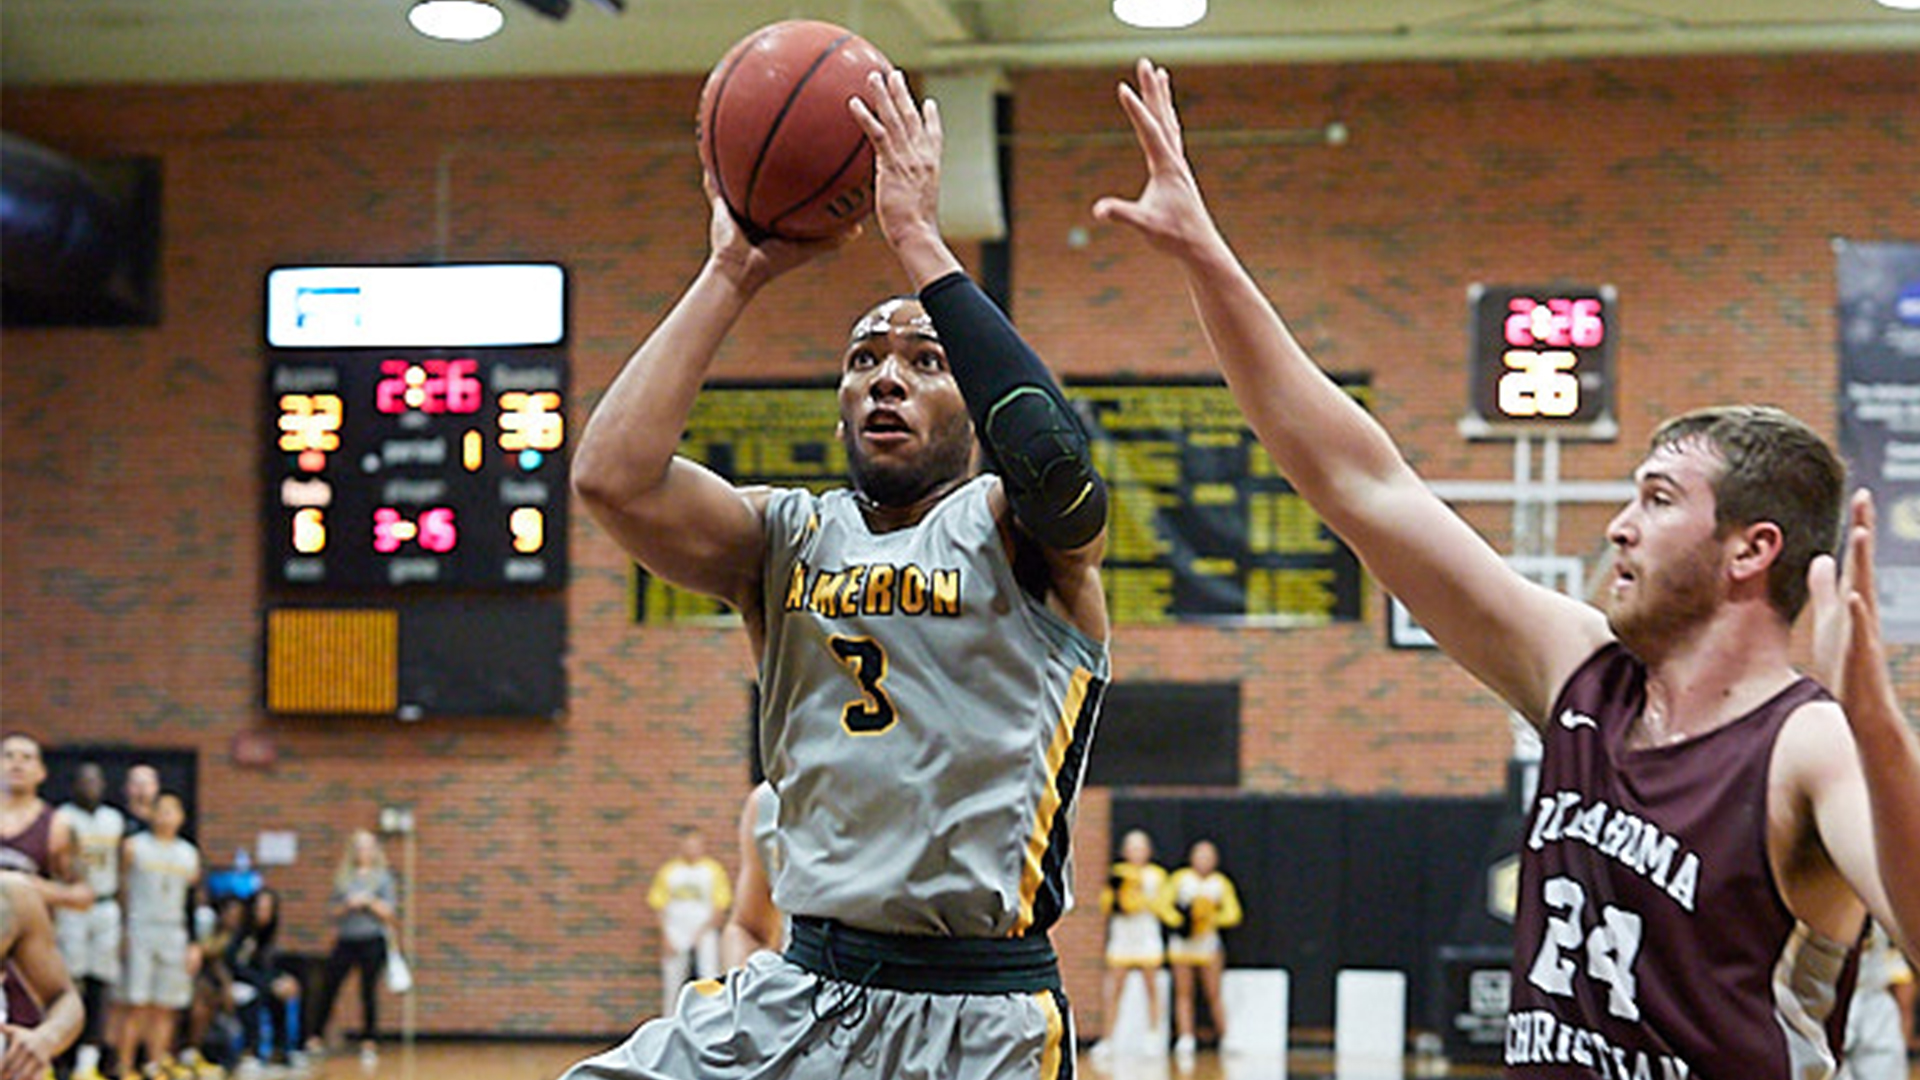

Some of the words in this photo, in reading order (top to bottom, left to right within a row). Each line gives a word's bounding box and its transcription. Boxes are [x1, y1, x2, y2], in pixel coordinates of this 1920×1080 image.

[1499, 351, 1578, 417] 26
[292, 507, 326, 554] 6
[509, 506, 544, 553] 9
[784, 558, 961, 619] AMERON
[827, 633, 899, 737] 3
[1527, 876, 1641, 1022] 24
